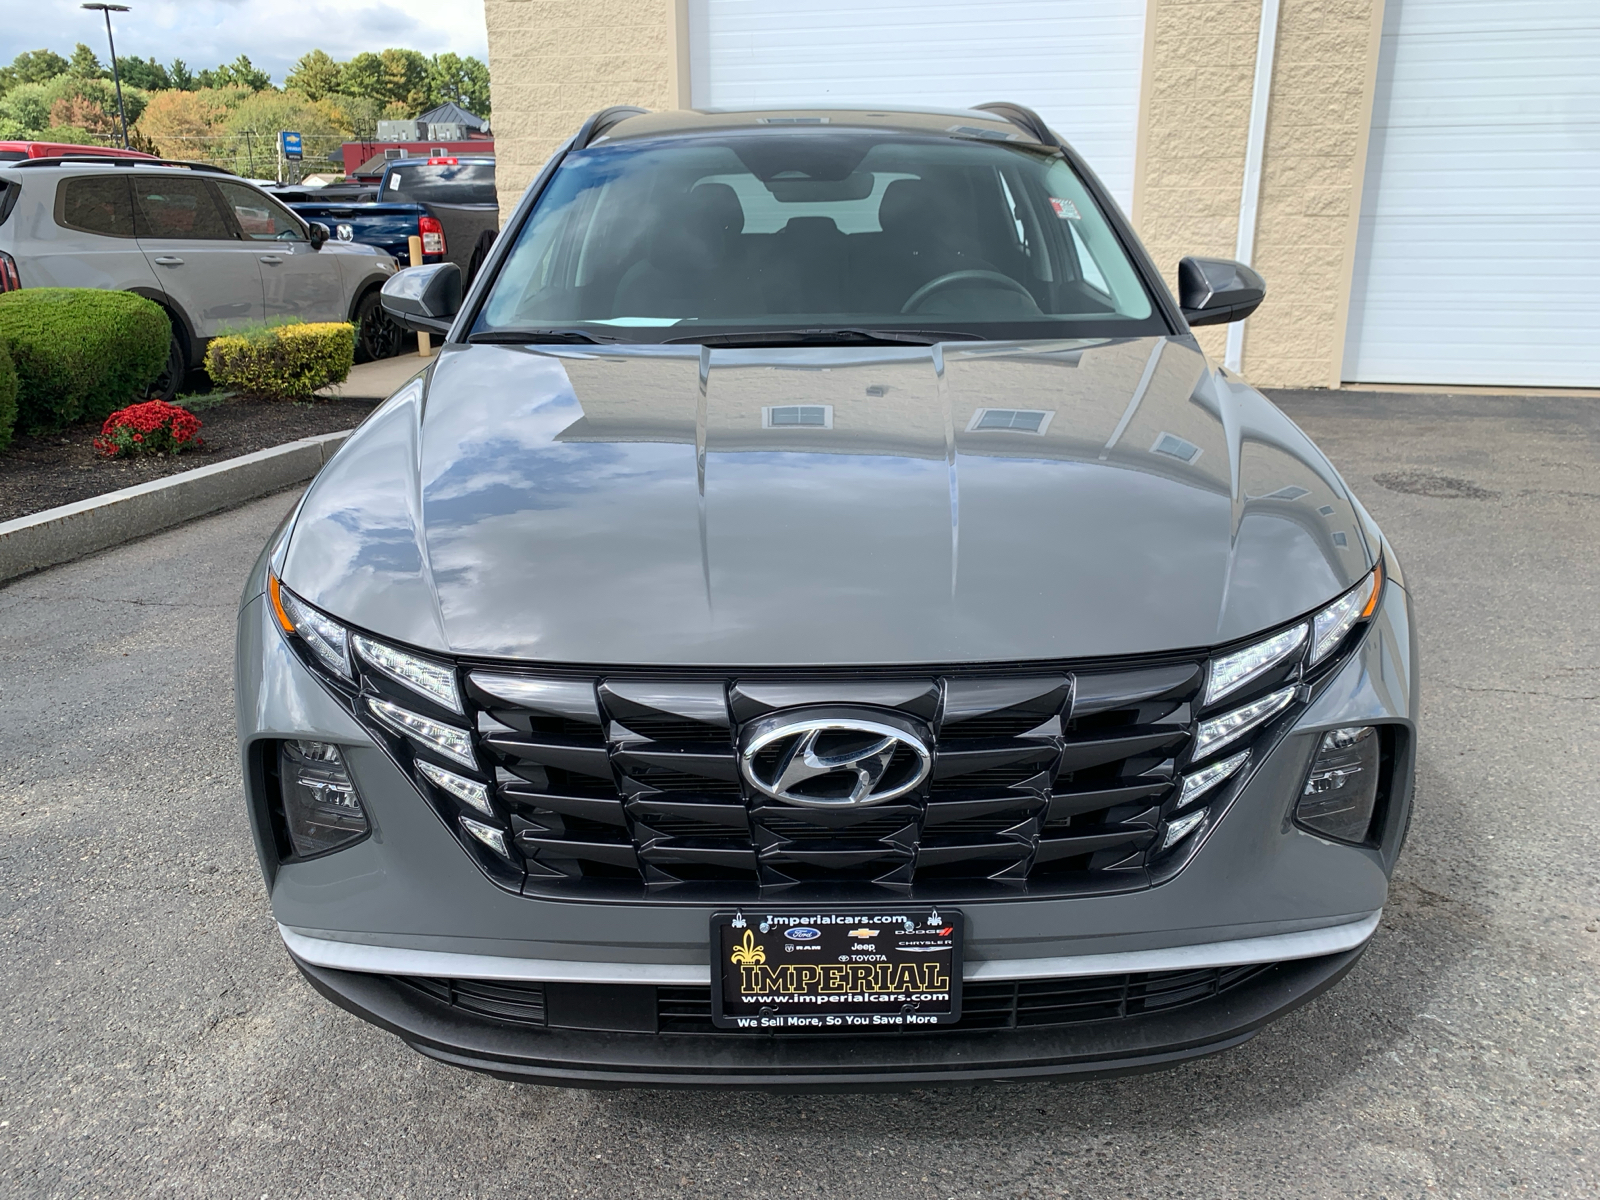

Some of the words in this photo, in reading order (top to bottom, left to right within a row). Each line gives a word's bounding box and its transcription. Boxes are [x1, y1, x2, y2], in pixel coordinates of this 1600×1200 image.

[766, 914, 908, 927] Imperialcars.com
[851, 942, 876, 952] Jeep
[851, 954, 888, 962] TOYOTA
[740, 963, 950, 994] IMPERIAL
[741, 993, 949, 1004] www.imperialcars.com
[737, 1018, 758, 1028] We
[760, 1017, 784, 1027] Sell
[787, 1016, 822, 1027] More,
[826, 1016, 842, 1026] So
[845, 1015, 870, 1025] You
[872, 1015, 903, 1024] Save
[906, 1014, 938, 1024] More
